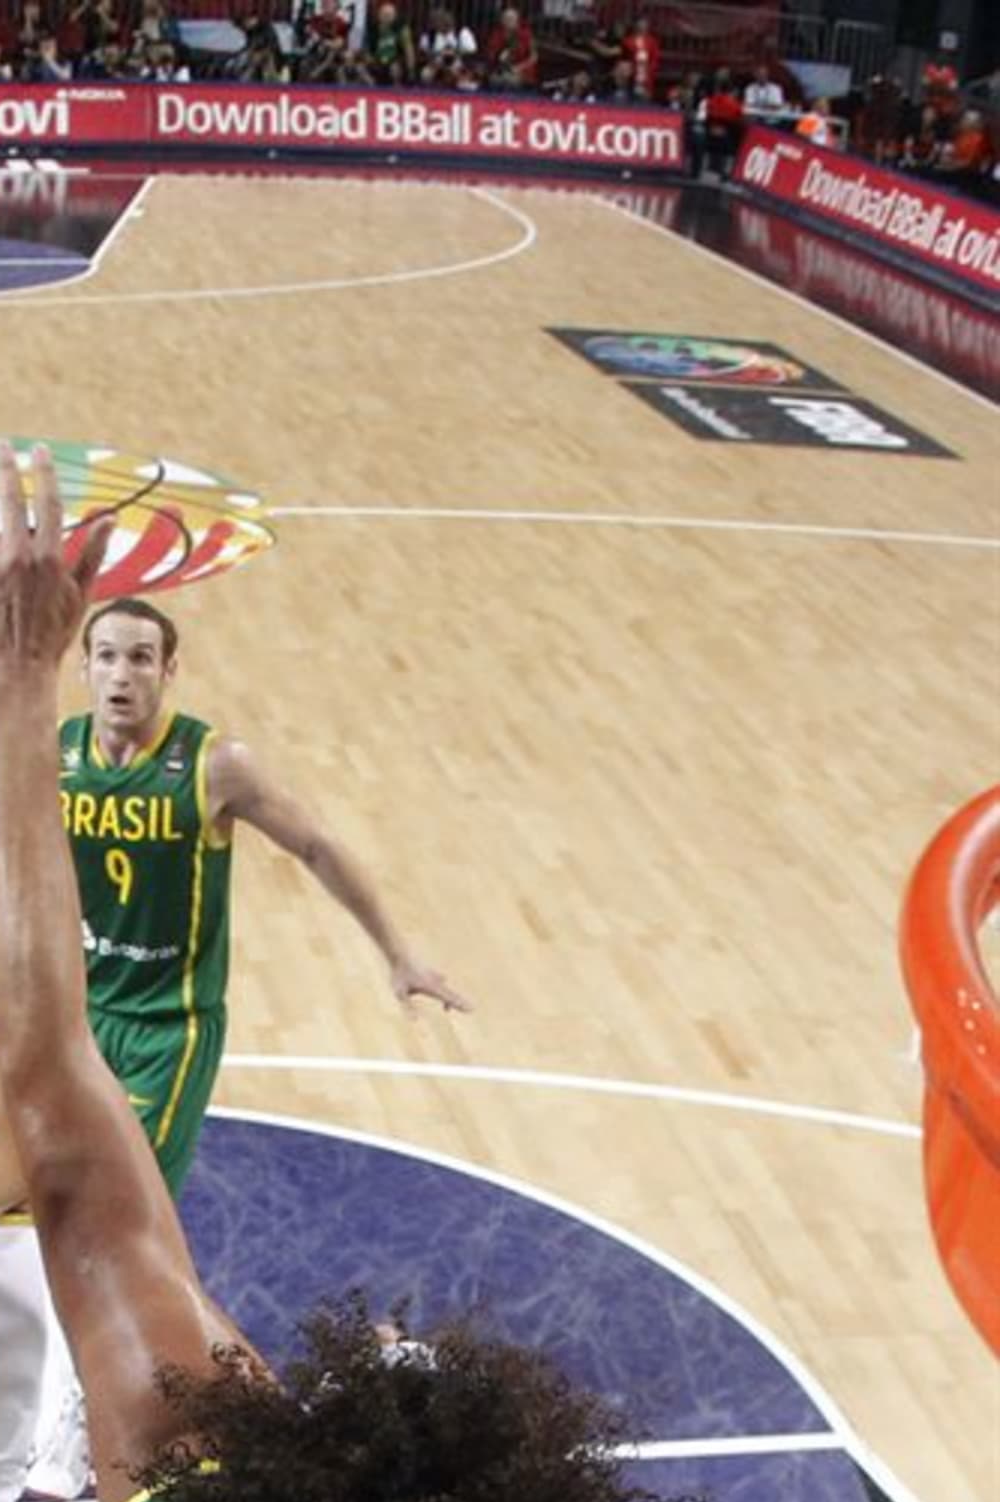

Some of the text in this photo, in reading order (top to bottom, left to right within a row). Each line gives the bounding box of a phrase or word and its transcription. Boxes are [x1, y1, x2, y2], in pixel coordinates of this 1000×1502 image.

[157, 93, 678, 160] Download BBall at ovi.com
[744, 146, 779, 187] ovi
[799, 158, 899, 232] Download
[886, 191, 946, 250] BBall
[933, 217, 966, 258] at
[105, 847, 133, 905] 9
